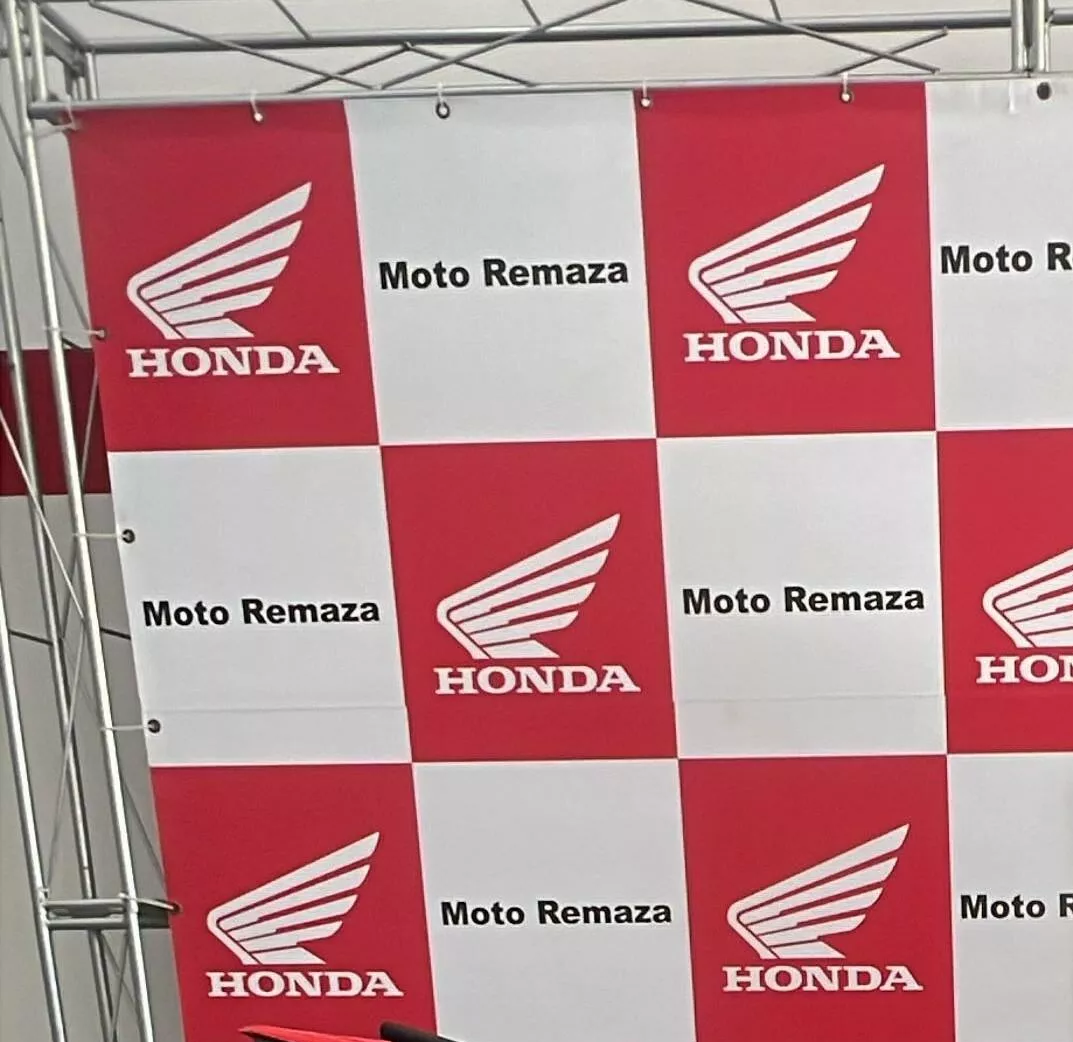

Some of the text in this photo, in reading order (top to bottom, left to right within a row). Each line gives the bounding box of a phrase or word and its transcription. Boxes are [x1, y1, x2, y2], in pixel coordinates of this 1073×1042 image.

[941, 245, 1033, 274] Moto
[379, 259, 628, 289] Moto Remaza
[683, 330, 900, 362] HONDA
[126, 346, 340, 378] HONDA
[143, 599, 379, 626] Moto Remaza
[683, 587, 925, 615] Moto Remaza
[434, 666, 641, 695] HONDA
[442, 901, 672, 926] Moto Remaza
[961, 895, 1046, 919] Moto
[207, 971, 404, 997] HONDA
[722, 966, 924, 992] HONDA
